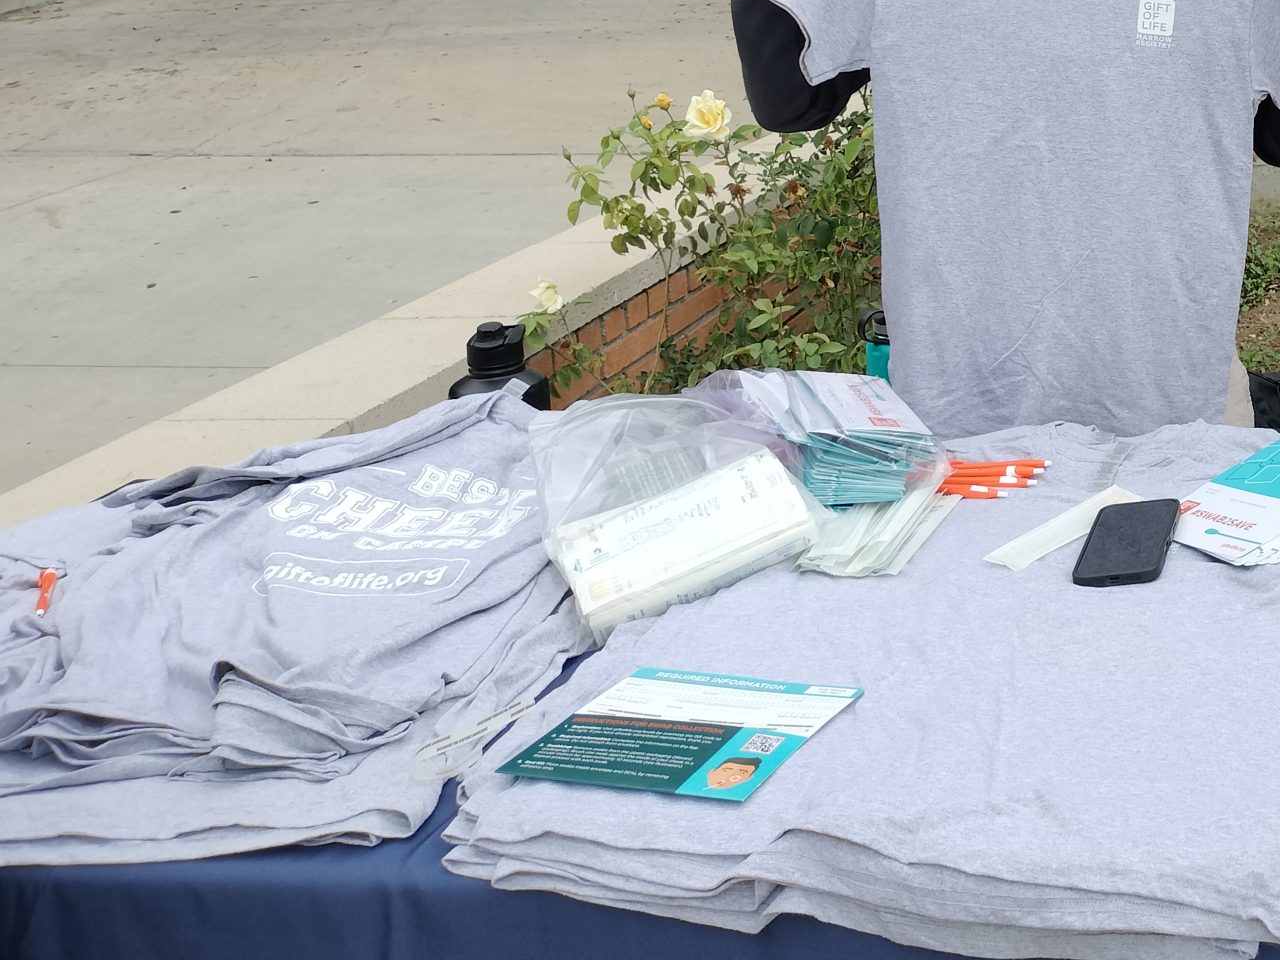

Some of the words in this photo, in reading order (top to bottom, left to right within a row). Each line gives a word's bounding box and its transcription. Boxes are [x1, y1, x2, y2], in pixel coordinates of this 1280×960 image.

[1144, 2, 1171, 13] GIFT
[1143, 12, 1160, 20] OF
[1142, 21, 1168, 32] LIFE
[1136, 34, 1173, 43] MARROW
[1136, 40, 1172, 49] REGISTRY
[1190, 509, 1257, 531] #SWAB2SAVE
[264, 563, 448, 590] giftoflife.org
[656, 671, 714, 683] REQUIRED
[709, 676, 788, 691] INFORMATION
[672, 724, 725, 734] COLLECTION
